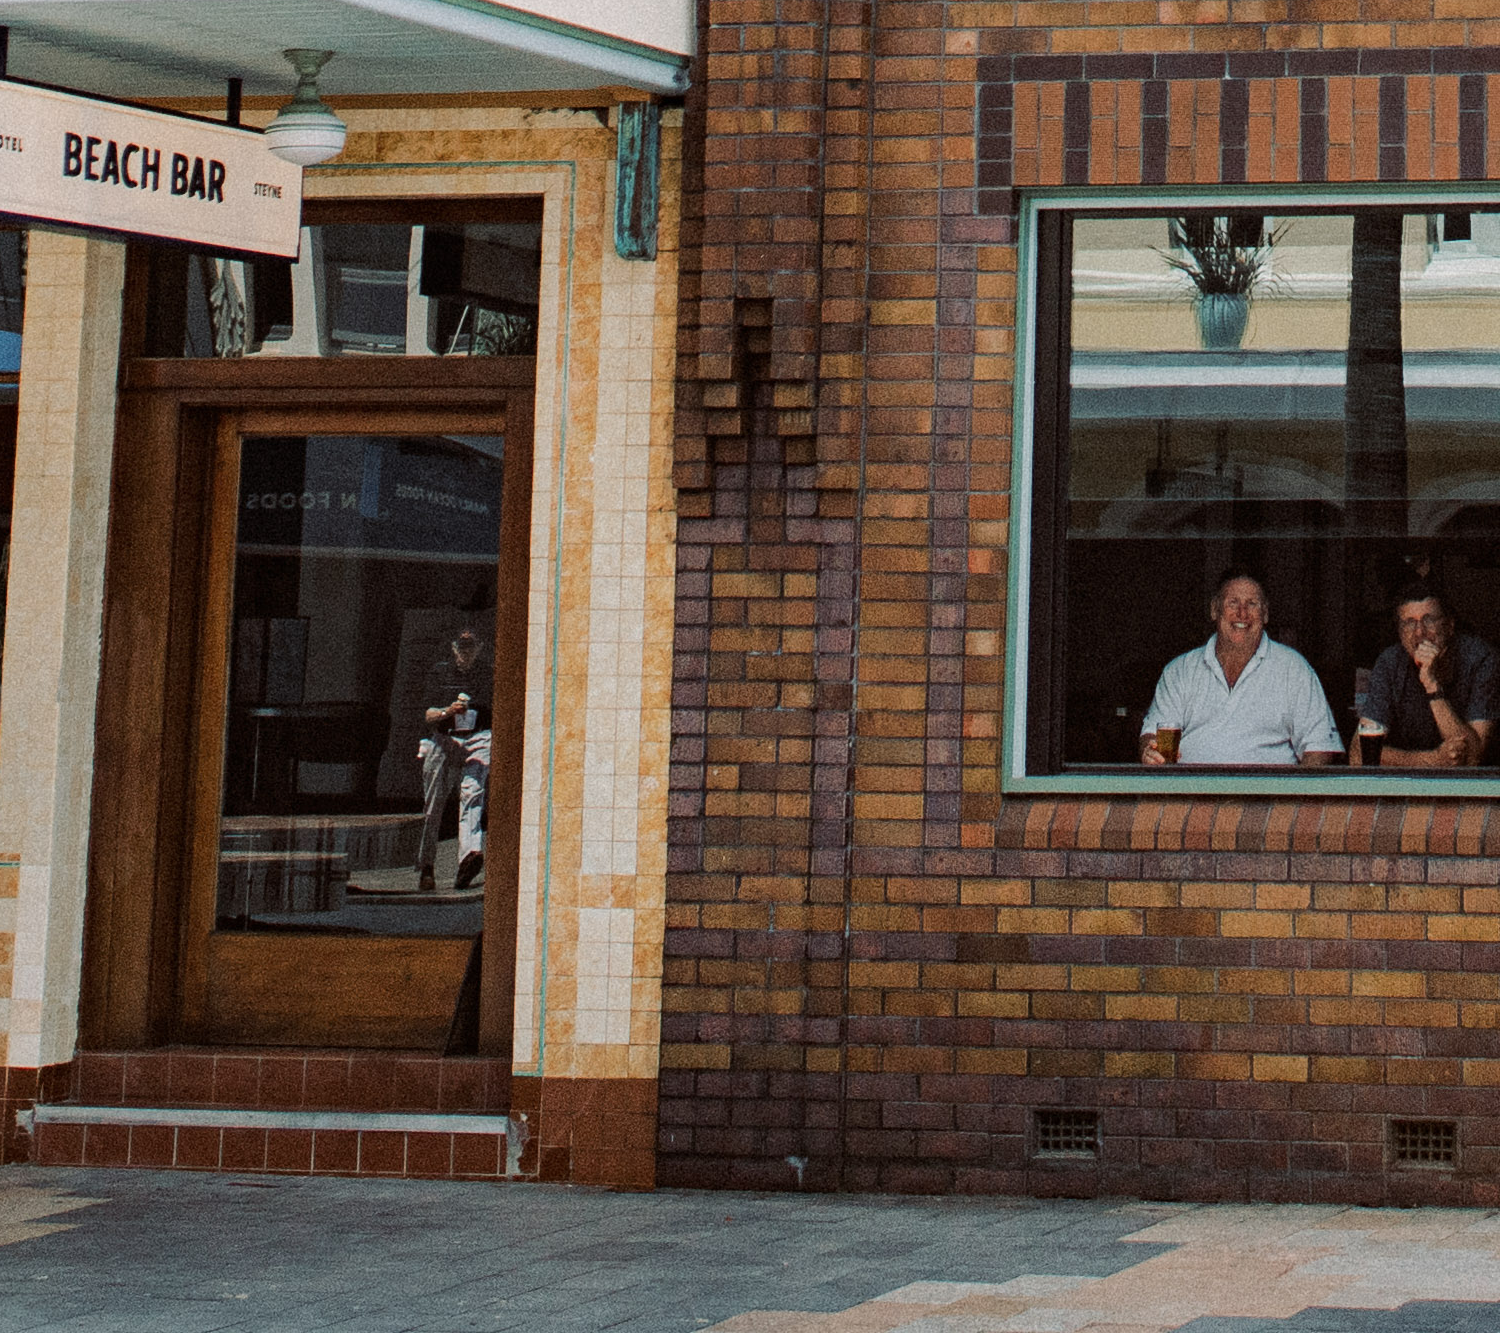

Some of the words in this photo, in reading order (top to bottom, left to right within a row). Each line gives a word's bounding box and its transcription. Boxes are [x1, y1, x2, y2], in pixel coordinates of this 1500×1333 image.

[63, 132, 160, 192] BEACH
[171, 153, 226, 203] BAR
[253, 182, 282, 199] STEYNE
